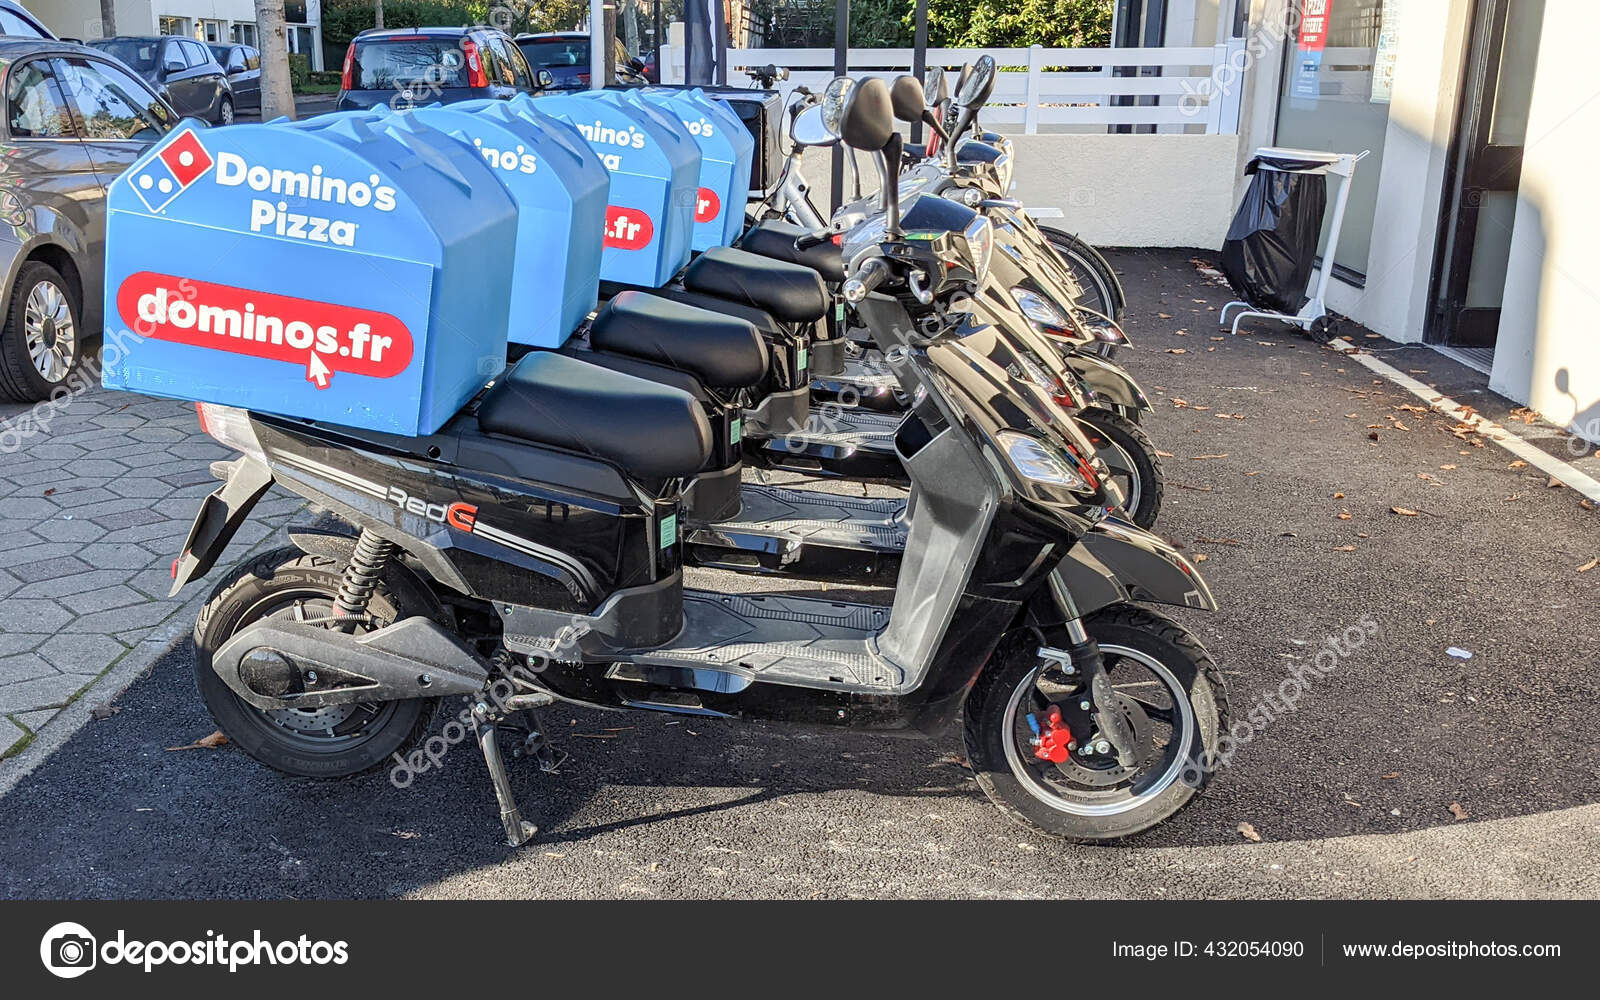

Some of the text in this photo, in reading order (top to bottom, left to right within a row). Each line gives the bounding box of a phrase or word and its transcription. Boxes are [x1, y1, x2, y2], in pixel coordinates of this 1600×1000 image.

[216, 151, 396, 211] Domino's
[250, 199, 356, 246] Pizza
[604, 215, 641, 241] .fr
[137, 287, 393, 362] dominos.fr
